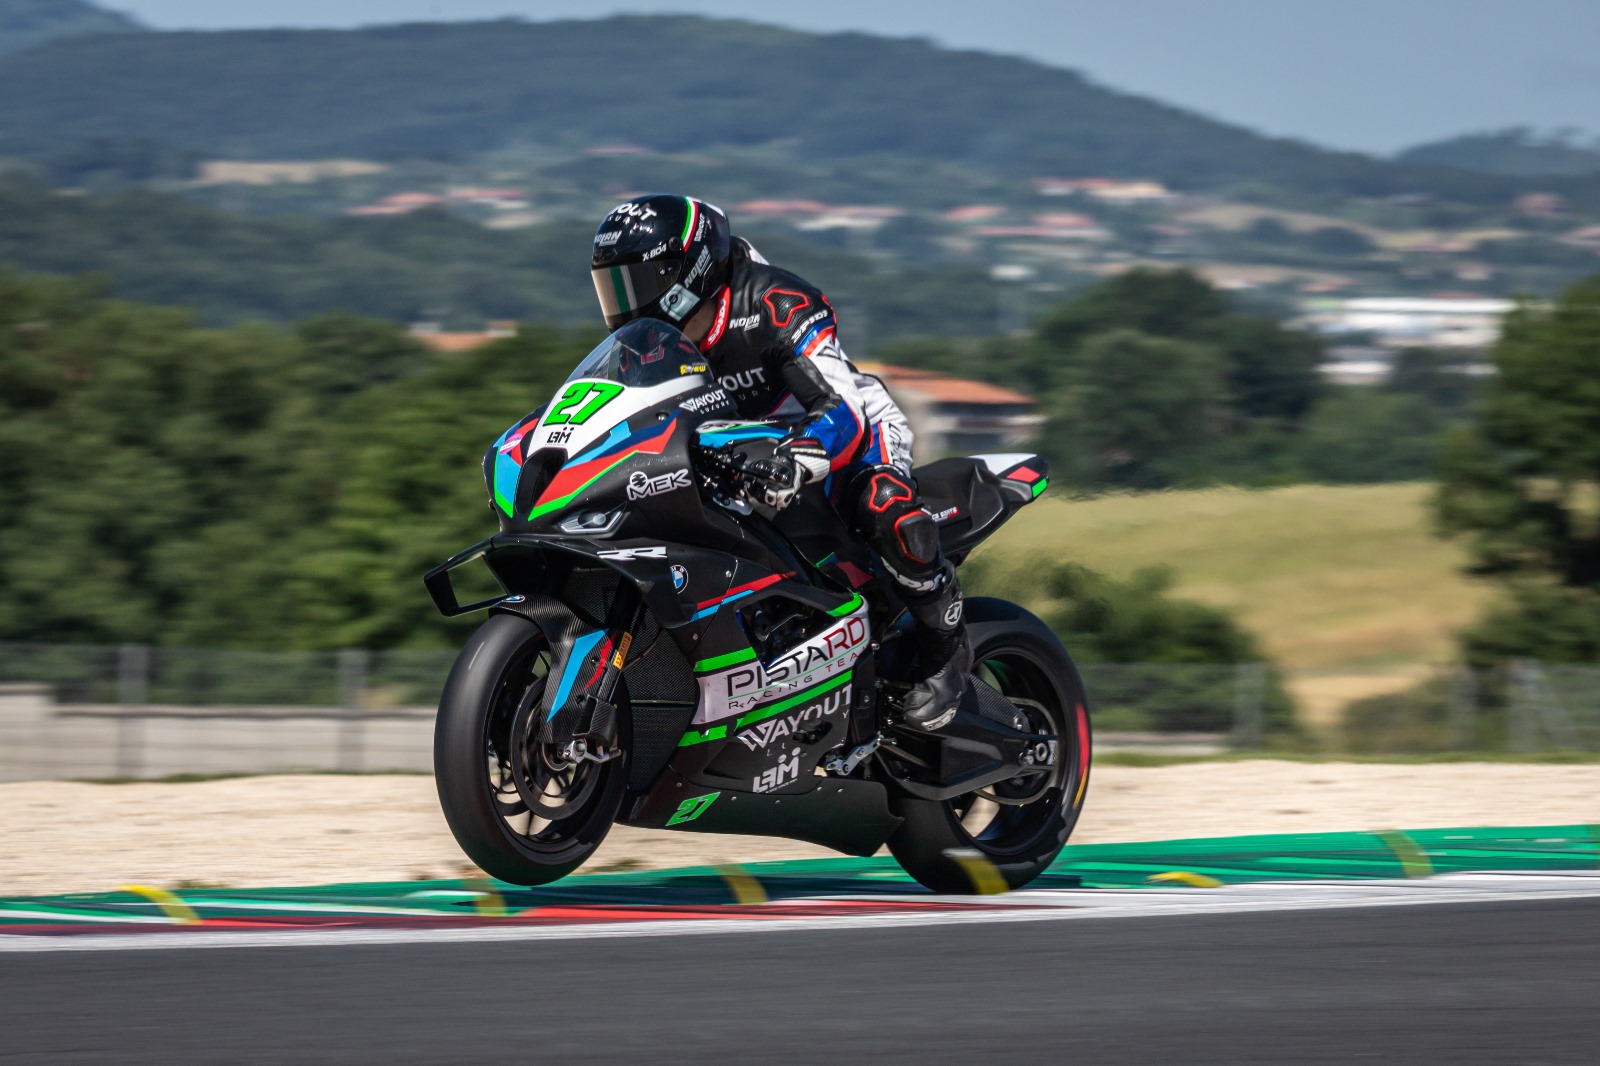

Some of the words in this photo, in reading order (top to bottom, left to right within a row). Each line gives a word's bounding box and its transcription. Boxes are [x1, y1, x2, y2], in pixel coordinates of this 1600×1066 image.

[684, 244, 711, 289] NOLAN
[543, 382, 625, 426] 27
[679, 389, 726, 412] WAYOUT
[627, 469, 692, 500] MEK
[727, 616, 865, 697] PISTARD
[728, 674, 813, 709] RACING
[825, 645, 866, 672] TEA
[665, 791, 721, 826] 27
